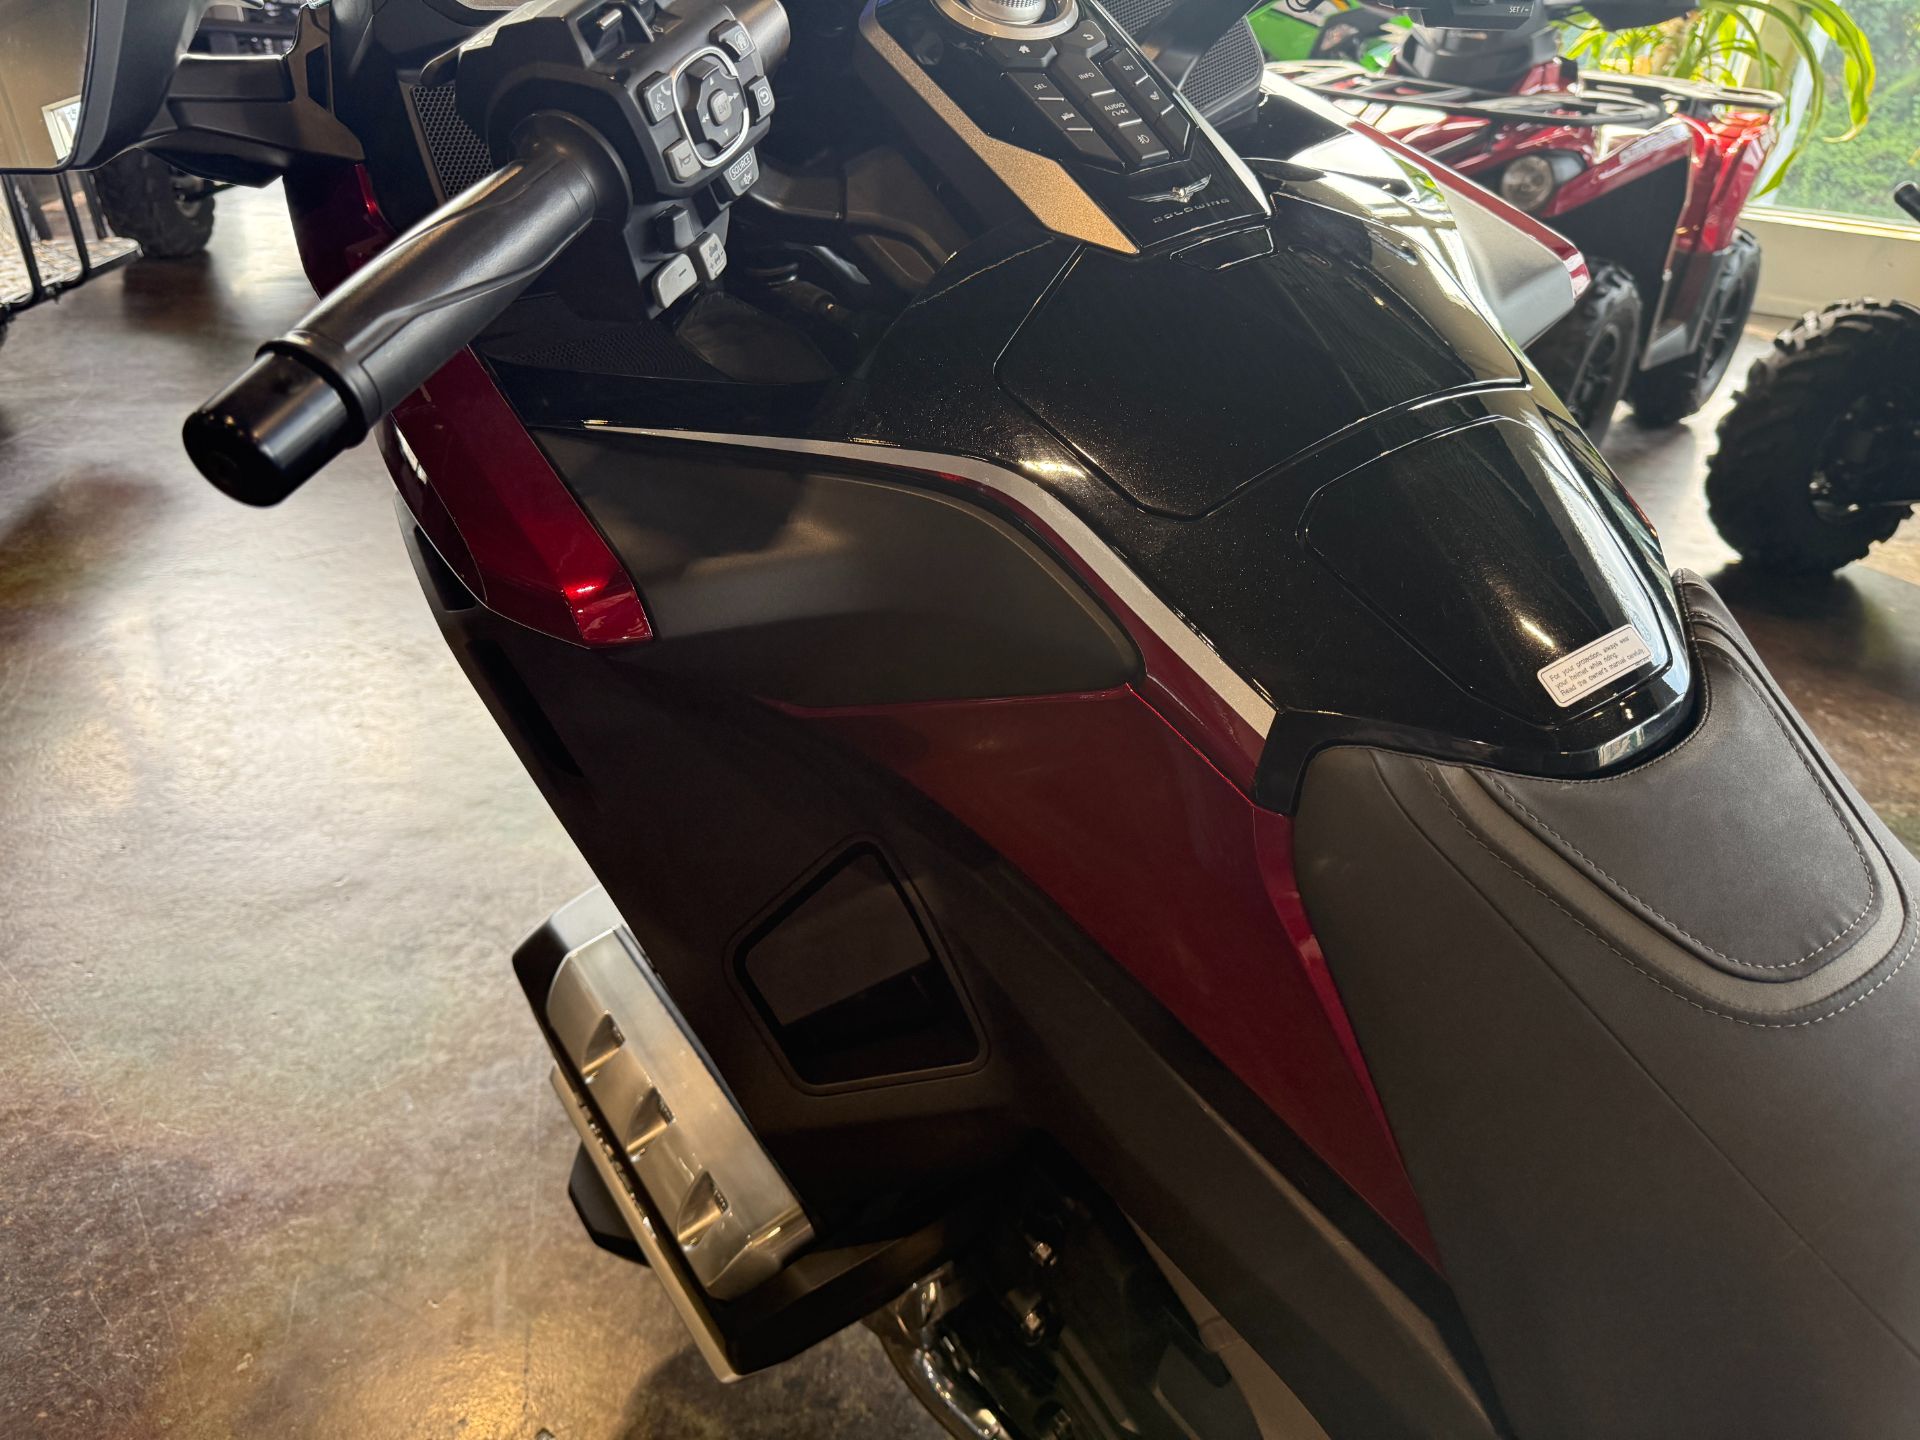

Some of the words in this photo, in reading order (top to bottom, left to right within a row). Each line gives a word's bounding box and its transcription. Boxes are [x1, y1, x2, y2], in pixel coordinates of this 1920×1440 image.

[1078, 72, 1095, 80] INFO
[1104, 102, 1126, 112] AUDIO
[731, 154, 751, 177] SOURCE
[1549, 673, 1560, 682] For
[1561, 665, 1575, 676] your
[1555, 679, 1569, 689] your
[1560, 684, 1577, 696] Read
